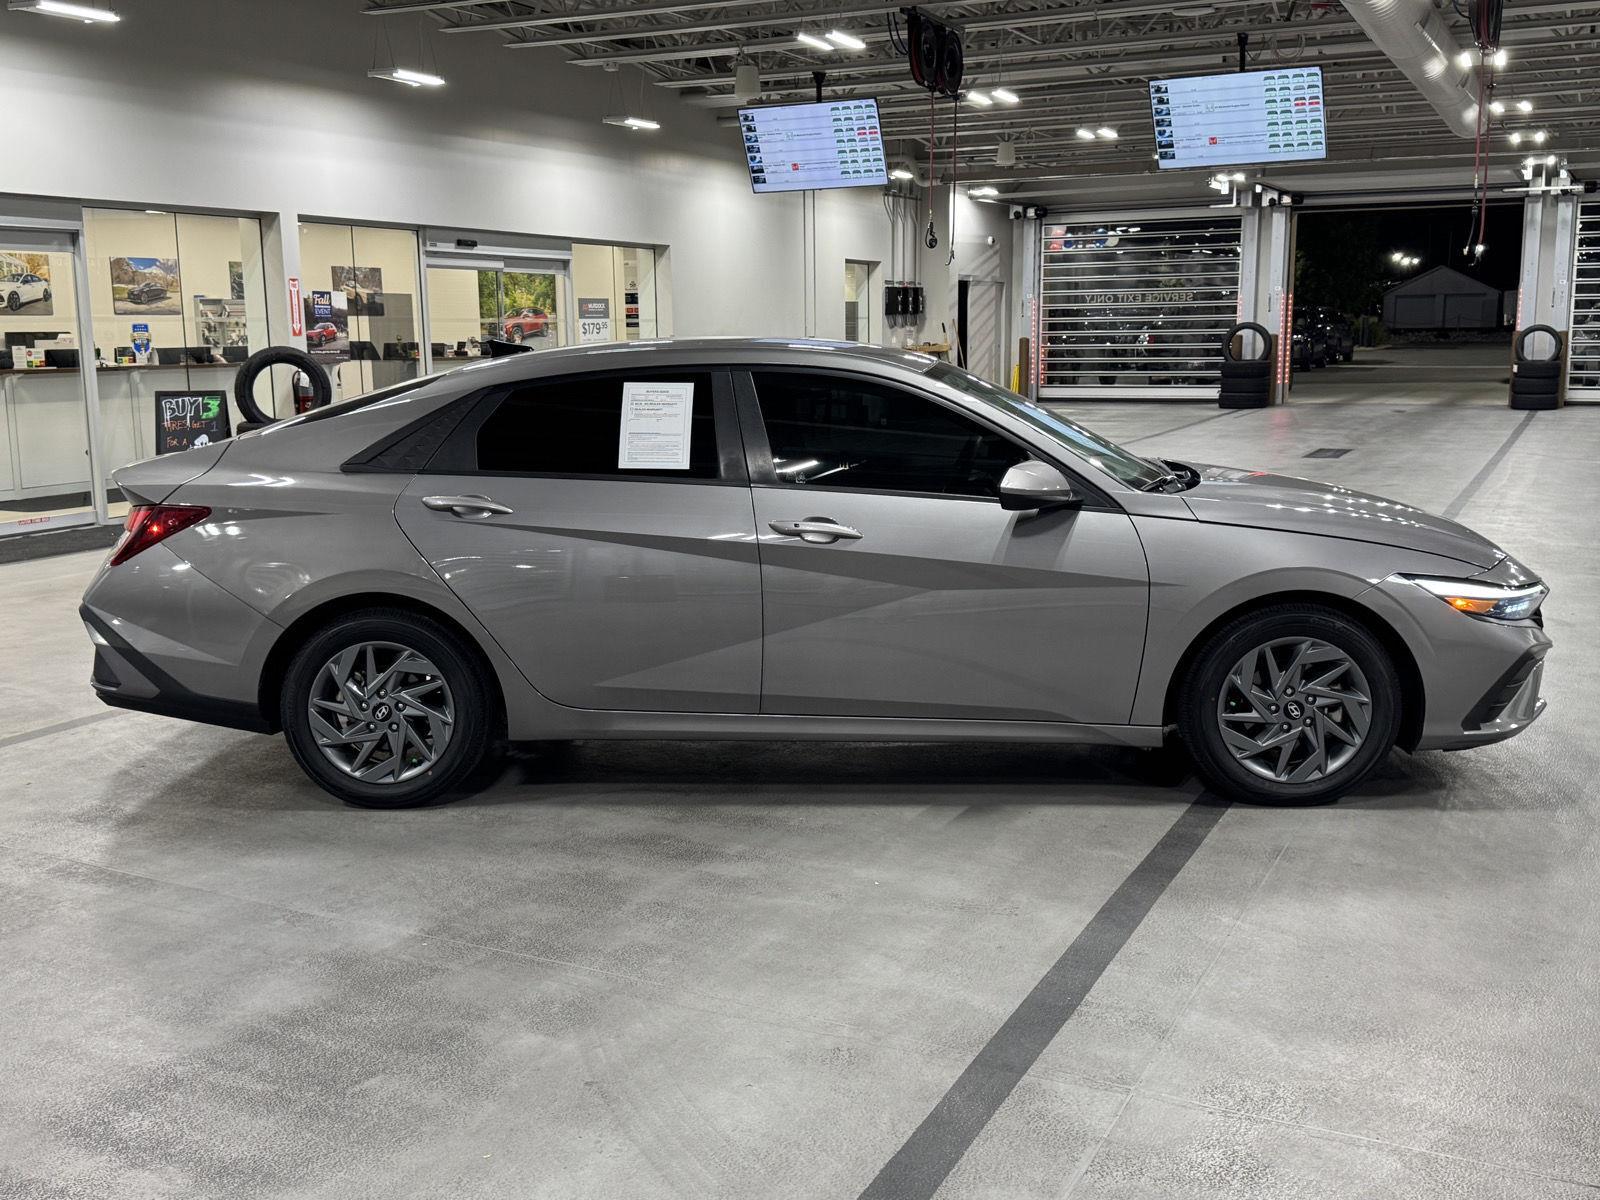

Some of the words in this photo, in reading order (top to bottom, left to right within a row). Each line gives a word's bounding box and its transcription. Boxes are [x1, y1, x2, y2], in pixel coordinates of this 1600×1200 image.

[313, 294, 331, 305] Fall
[162, 397, 202, 418] BUY
[201, 396, 221, 419] 3
